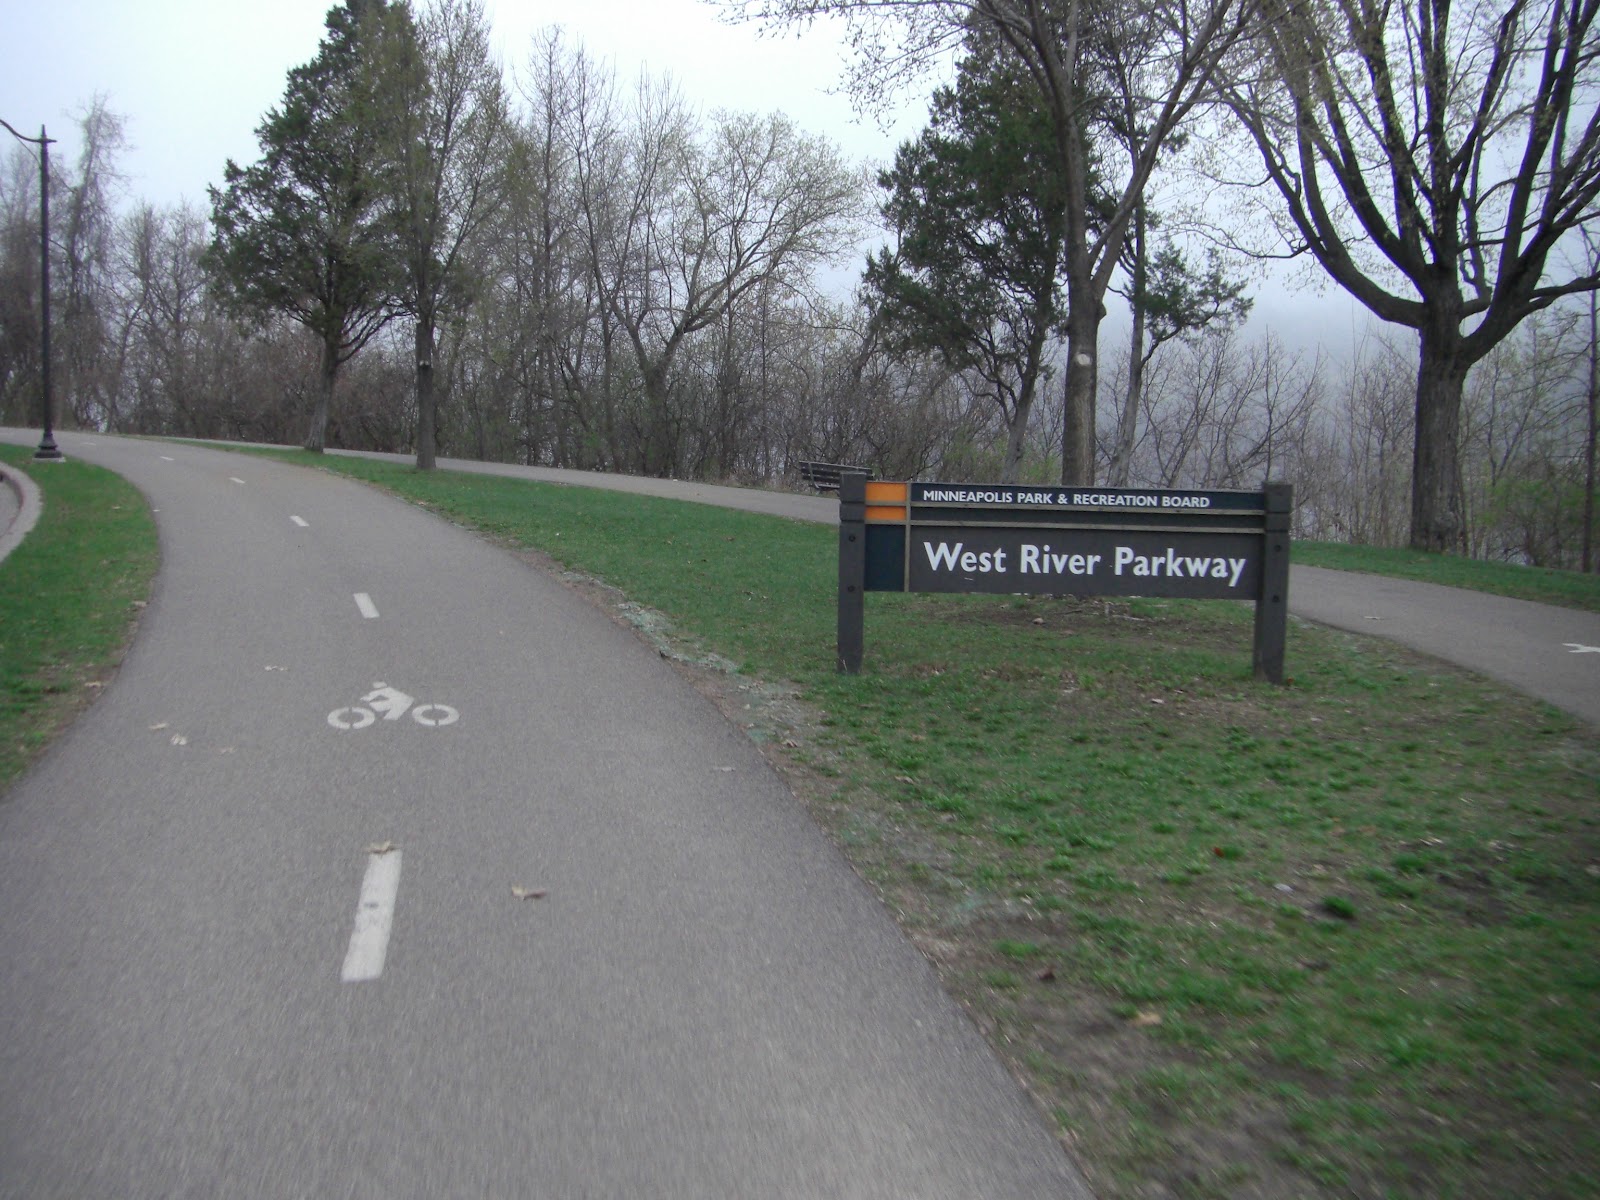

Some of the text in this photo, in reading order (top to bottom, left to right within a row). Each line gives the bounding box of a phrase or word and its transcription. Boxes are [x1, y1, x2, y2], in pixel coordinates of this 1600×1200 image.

[923, 490, 1210, 508] MINNEAPOLIS PARK & RECREATION BOARD
[923, 541, 1246, 587] West River Parkway
